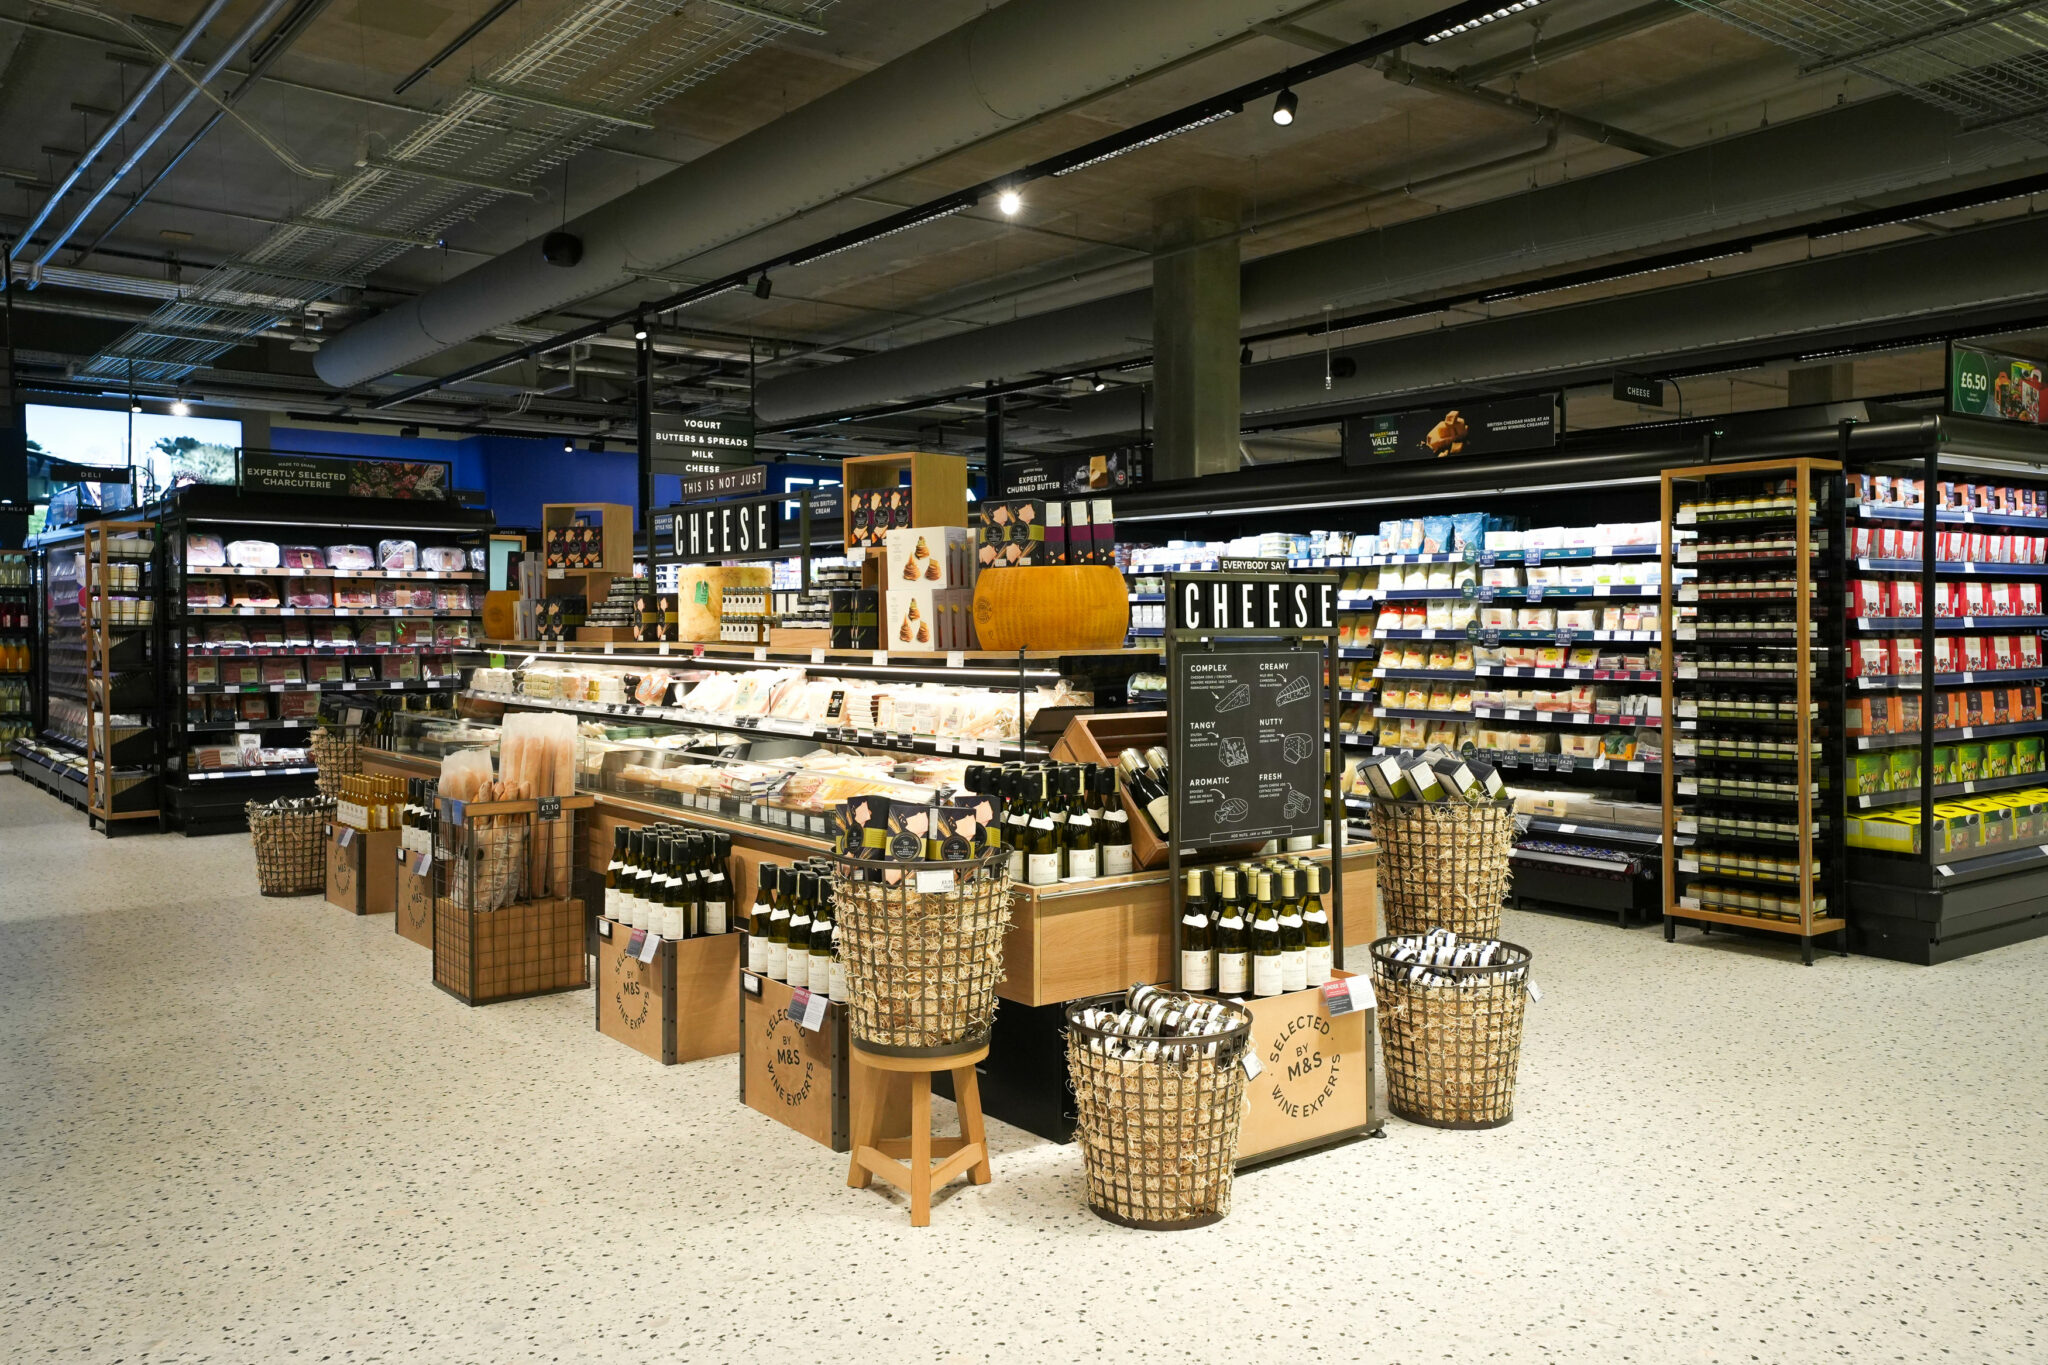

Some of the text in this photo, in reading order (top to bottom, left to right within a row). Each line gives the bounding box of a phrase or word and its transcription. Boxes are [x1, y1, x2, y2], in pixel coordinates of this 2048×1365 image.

[1961, 371, 1987, 391] £6.50
[1627, 386, 1650, 398] CHEESE
[684, 419, 721, 430] YOGURT
[655, 432, 696, 443] BUTTERS
[707, 436, 748, 447] SPREADS
[1371, 436, 1398, 446] VALUE
[691, 450, 713, 459] MILK
[247, 468, 346, 481] EXPERTLY SELECTED
[685, 464, 720, 473] CHEESE
[263, 478, 331, 488] CHARCUTERIE
[684, 472, 762, 494] THIS IS NOT JUST
[1018, 474, 1048, 484] EXPERTLY
[1006, 482, 1060, 494] CHURNED BUTTER
[675, 504, 767, 556] CHEESE
[1222, 560, 1286, 570] EVERYBODY SAY
[1185, 582, 1333, 630] CHEESE
[1190, 664, 1228, 672] COMPLEX
[1259, 662, 1289, 671] CREAMY
[1190, 721, 1216, 730] TANGY
[1259, 717, 1283, 726] NUTTY
[1189, 776, 1230, 787] AROMATIC
[1259, 772, 1282, 781] FRESH
[541, 803, 559, 811] £1.10
[615, 948, 645, 975] SELEED
[627, 970, 634, 979] BY
[623, 981, 640, 995] M&S
[616, 991, 650, 1030] WINE EXPERTS
[766, 1008, 806, 1040] SELECED
[782, 1035, 792, 1046] BY
[1269, 1014, 1330, 1063] SELECTED
[1295, 1043, 1309, 1058] BY
[777, 1049, 800, 1066] M&S
[1287, 1051, 1323, 1082] M&S
[767, 1060, 814, 1107] WINE EXPERTS
[1271, 1053, 1341, 1118] WINE EXPERTS
